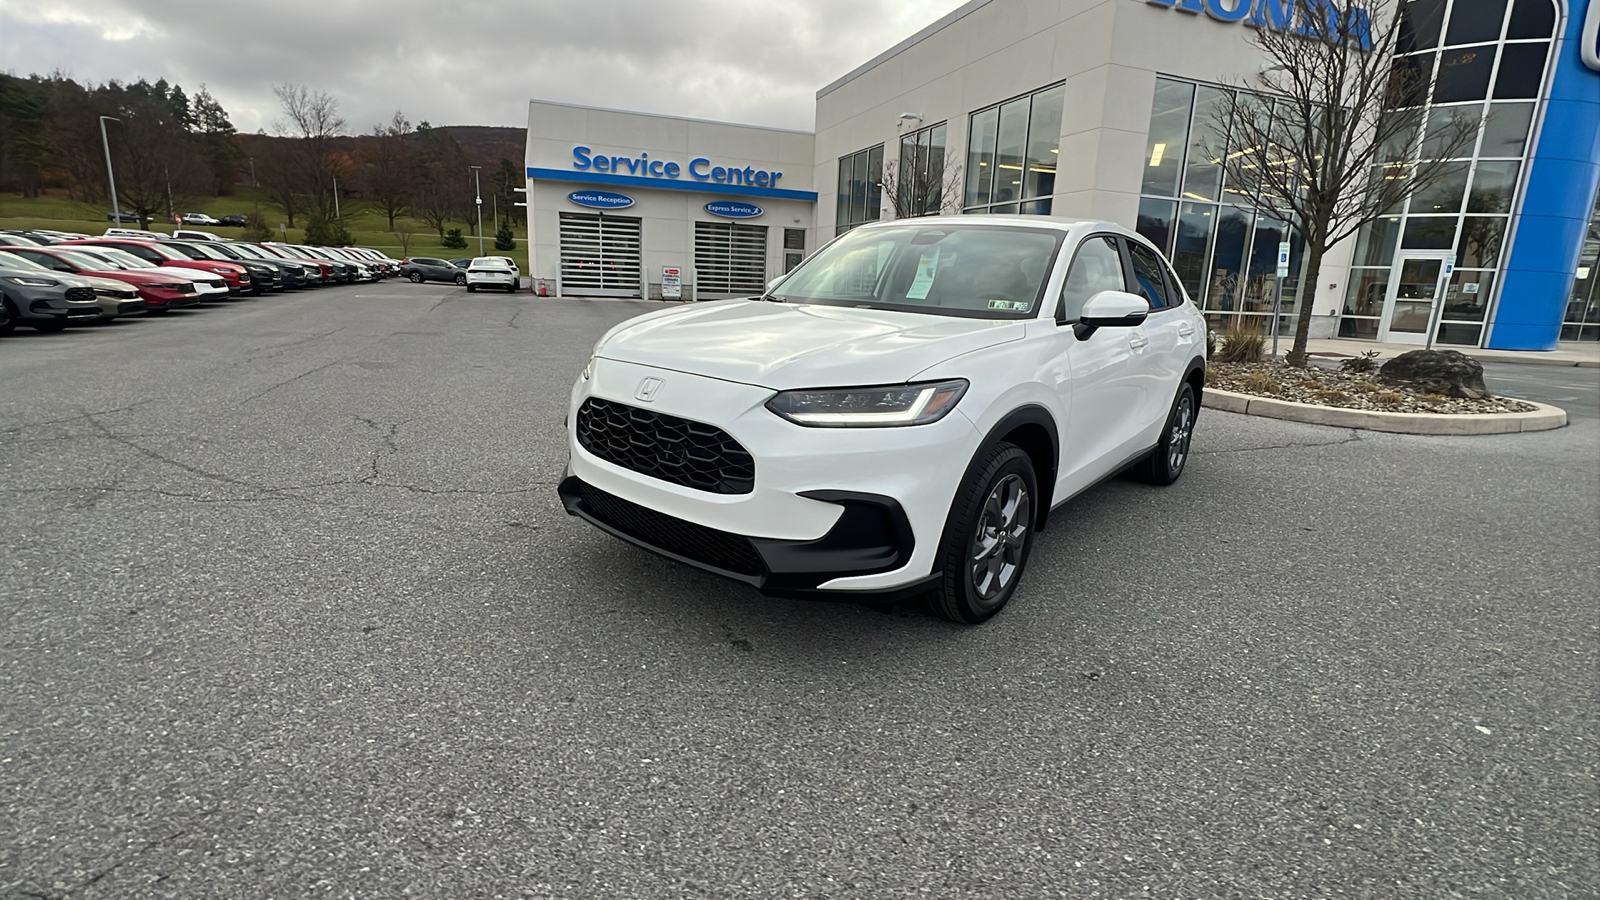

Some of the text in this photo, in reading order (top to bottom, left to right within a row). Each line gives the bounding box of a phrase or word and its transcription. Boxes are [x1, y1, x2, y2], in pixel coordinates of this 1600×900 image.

[1146, 0, 1371, 50] ONDA
[573, 146, 783, 188] Service Center
[572, 193, 631, 204] Service Reception
[707, 204, 730, 212] Express
